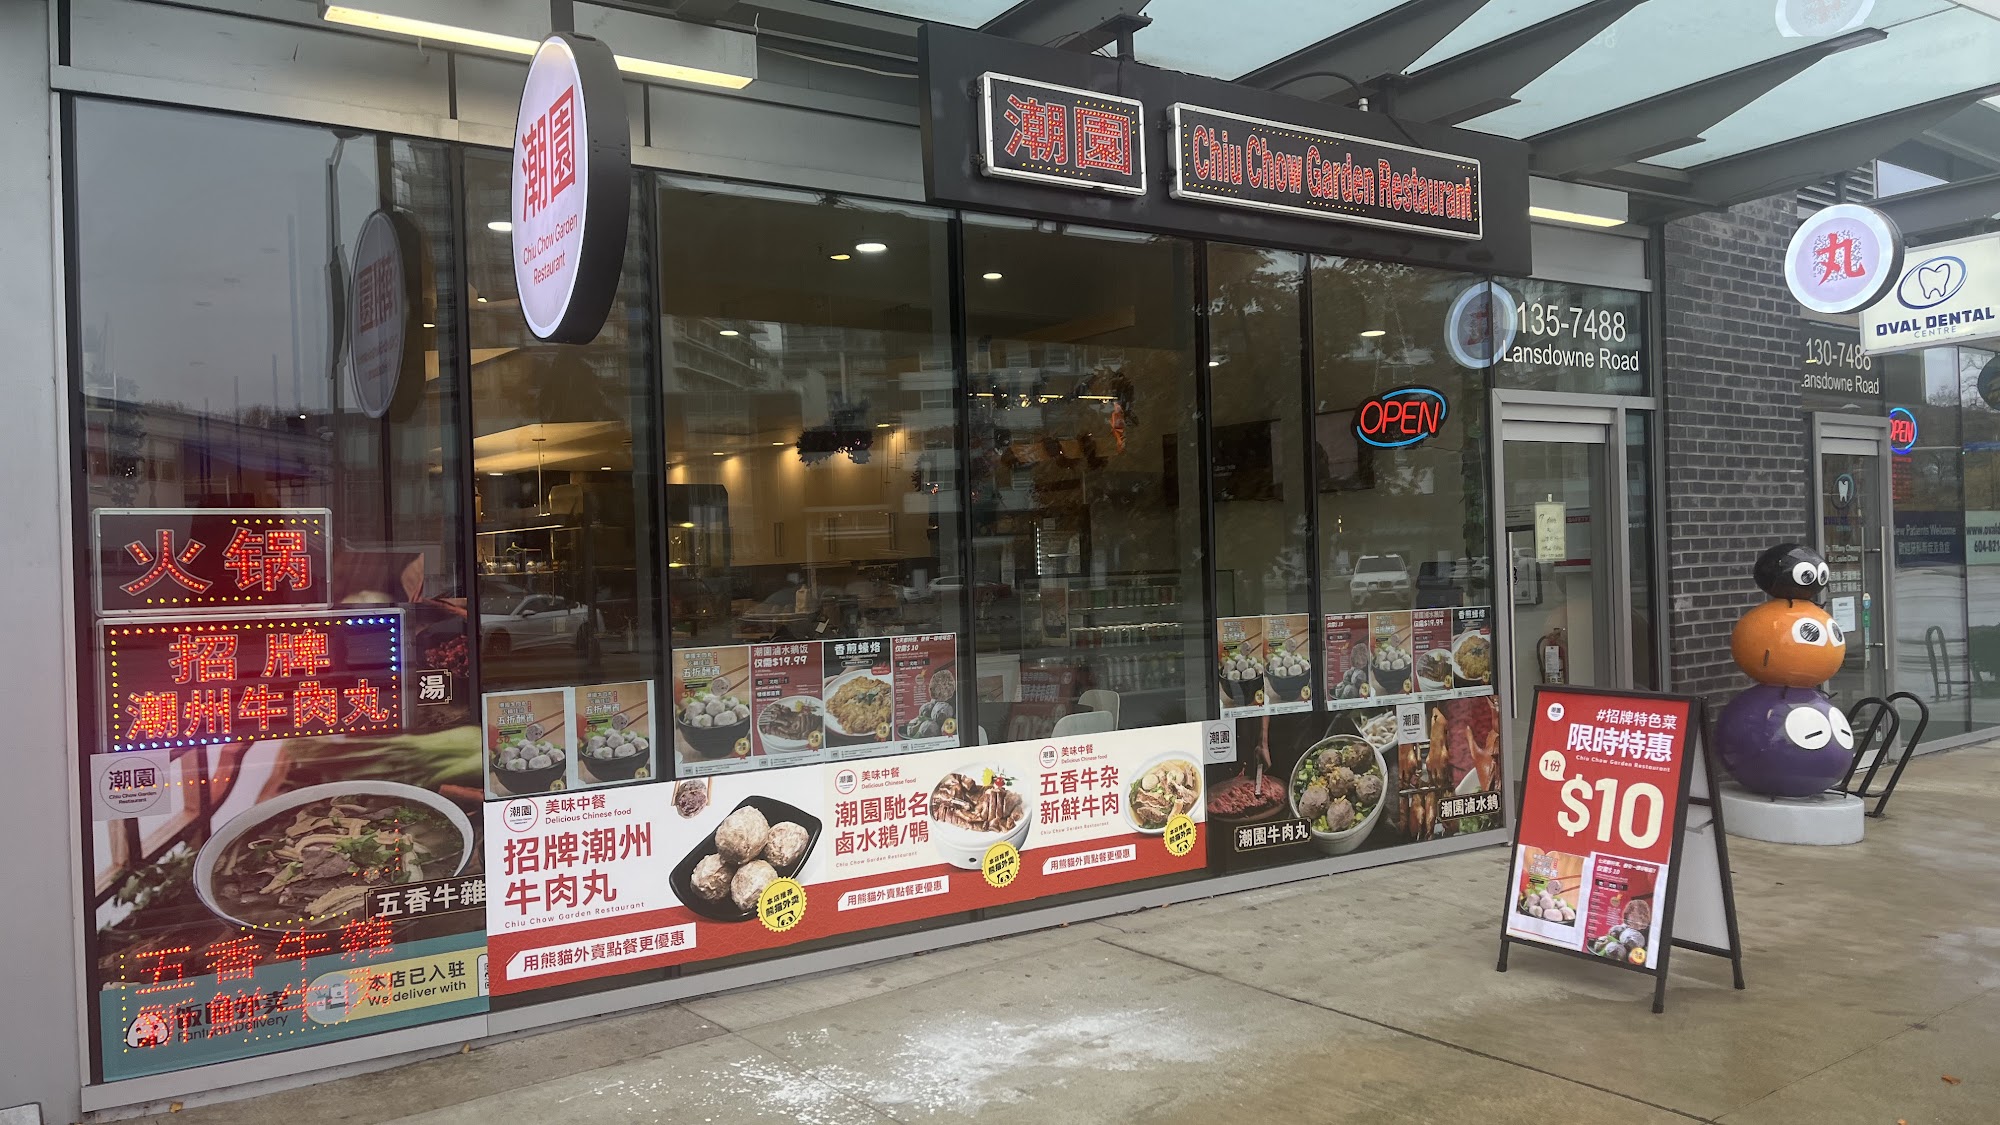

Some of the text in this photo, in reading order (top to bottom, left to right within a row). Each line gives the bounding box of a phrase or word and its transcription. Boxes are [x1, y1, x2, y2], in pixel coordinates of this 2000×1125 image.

[1004, 95, 1133, 175] 潮園
[521, 84, 577, 222] 潮園
[1193, 124, 1472, 221] Chiu Chow Garden Restaurant
[523, 214, 578, 265] Chiu Chow Garden
[533, 252, 565, 287] Restaurant
[1815, 233, 1866, 287] 丸
[1516, 302, 1626, 343] 135-7488
[1876, 306, 1995, 337] OVAL DENTAL
[1914, 326, 1957, 338] CENTRE
[1502, 339, 1640, 372] Lansdowne Road
[1801, 372, 1880, 395] ansdowne Road
[1360, 401, 1440, 434] OPEN
[1906, 524, 1929, 536] Patients
[1930, 524, 1957, 536] Welcome
[120, 528, 313, 595] 火锅
[169, 628, 331, 684] 招牌
[419, 675, 445, 700] 湯
[125, 678, 391, 741] 潮州牛肉丸
[1596, 708, 1678, 730] #招牌特色菜
[1062, 744, 1094, 757] 美味中餐
[1567, 723, 1675, 762] 限時特惠
[109, 768, 155, 790] 潮園
[862, 767, 900, 782] 美味中餐
[1040, 765, 1119, 796] 五香牛杂
[1591, 756, 1608, 764] Chow
[1610, 759, 1632, 768] Garden
[1634, 763, 1670, 772] Restaurant
[509, 805, 532, 817] 潮園
[545, 794, 606, 815] 美味中餐
[545, 808, 631, 824] Delicious Chinese food
[835, 792, 928, 828] 潮園馳名
[1041, 792, 1120, 825] 新鮮牛肉
[1557, 773, 1664, 849] $10
[503, 821, 652, 876] 招牌潮州
[1238, 824, 1309, 848] 潮園牛肉丸
[375, 880, 486, 917] 五香牛雜
[504, 869, 617, 916] 牛肉丸
[505, 902, 645, 929] Chiu Chow Garden Restaurant
[523, 930, 685, 972] 用熊貓外賣點餐更優惠
[369, 961, 465, 991] 本店已入驻
[368, 980, 466, 1006] We deliver with
[235, 1015, 289, 1032] Delivery
